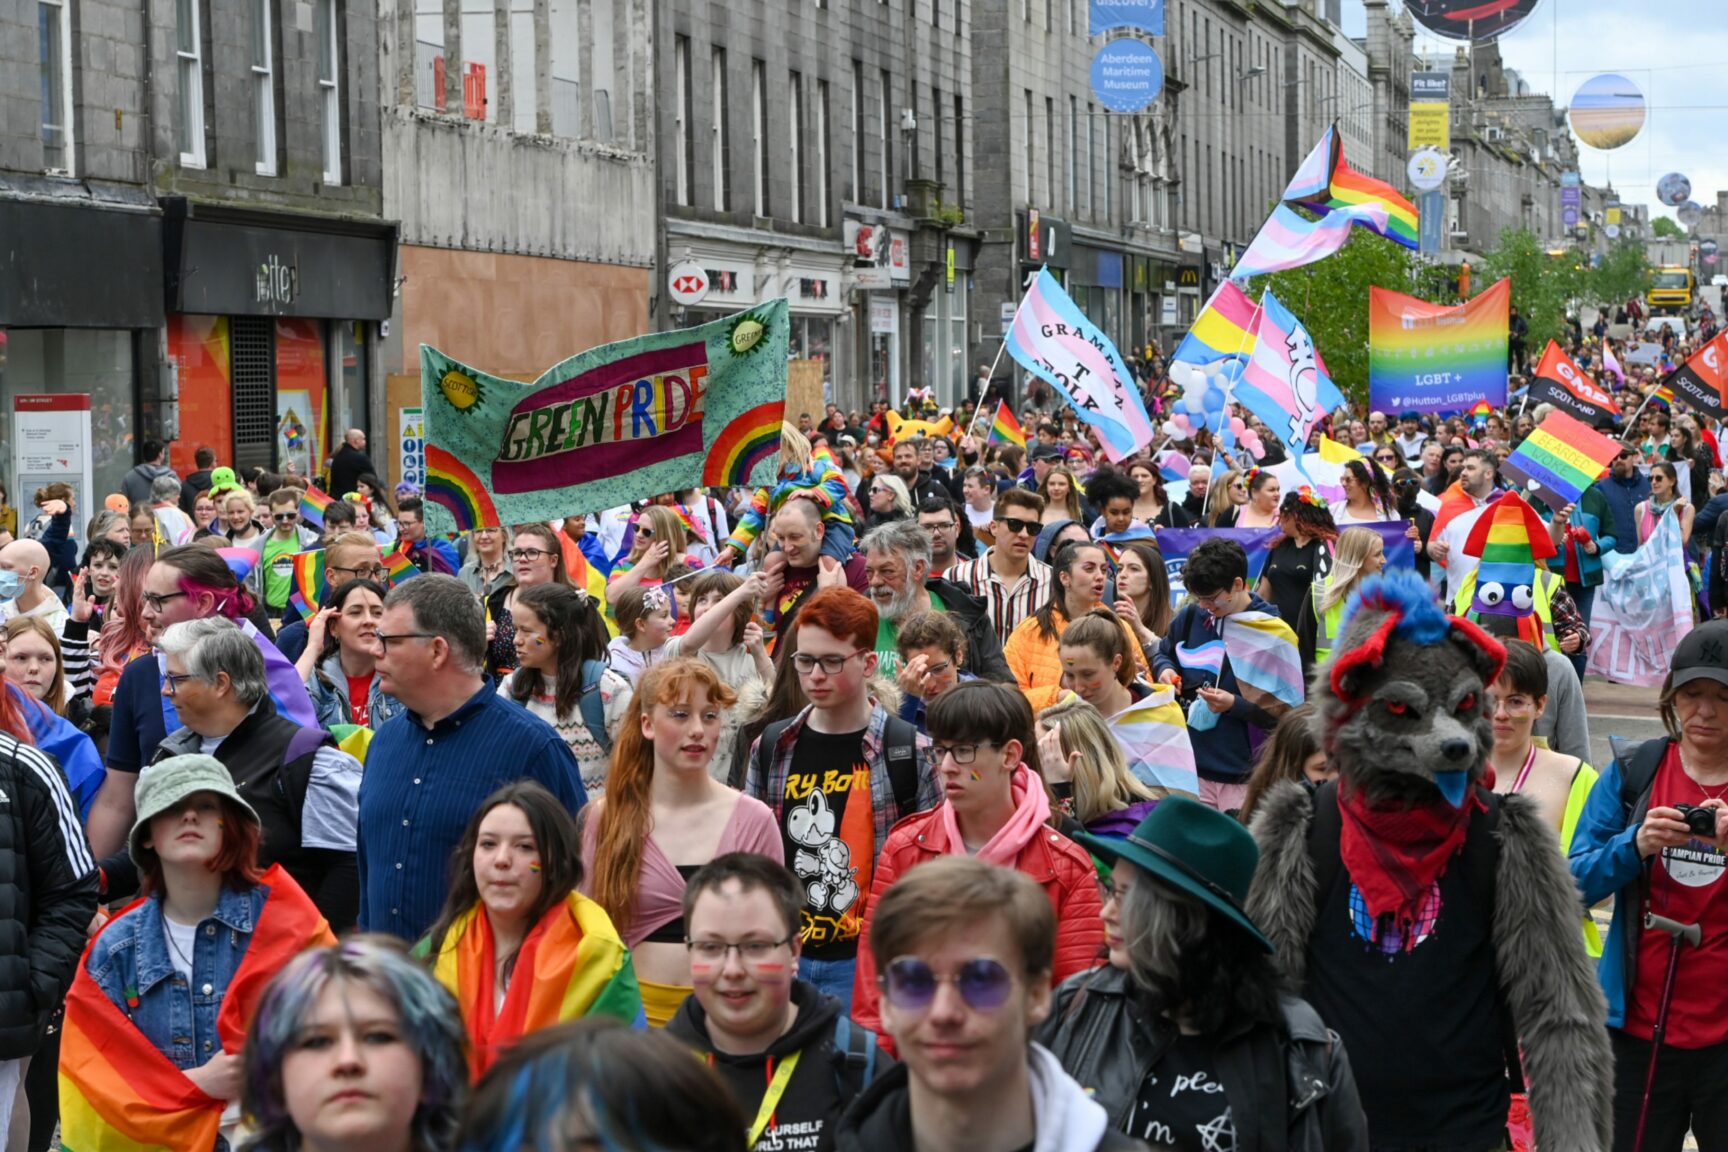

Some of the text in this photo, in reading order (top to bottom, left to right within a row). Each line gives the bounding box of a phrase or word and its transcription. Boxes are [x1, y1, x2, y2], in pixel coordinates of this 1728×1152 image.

[1101, 54, 1152, 64] Aberdeen
[1103, 66, 1151, 77] Maritime
[1104, 80, 1150, 89] Museum
[1041, 323, 1124, 410] GRAMPIAN
[1415, 372, 1451, 386] LGBT
[1555, 361, 1610, 405] GMB
[1548, 386, 1596, 416] SCOTLAND
[1676, 376, 1720, 408] SCOTLAND
[501, 366, 707, 461] GREEN PRIDE
[1531, 447, 1572, 477] WOKE
[785, 773, 818, 799] RY
[1662, 846, 1726, 866] GAMPIAN PRIDE
[764, 1120, 823, 1138] OURSELF
[786, 1136, 819, 1150] THAT
